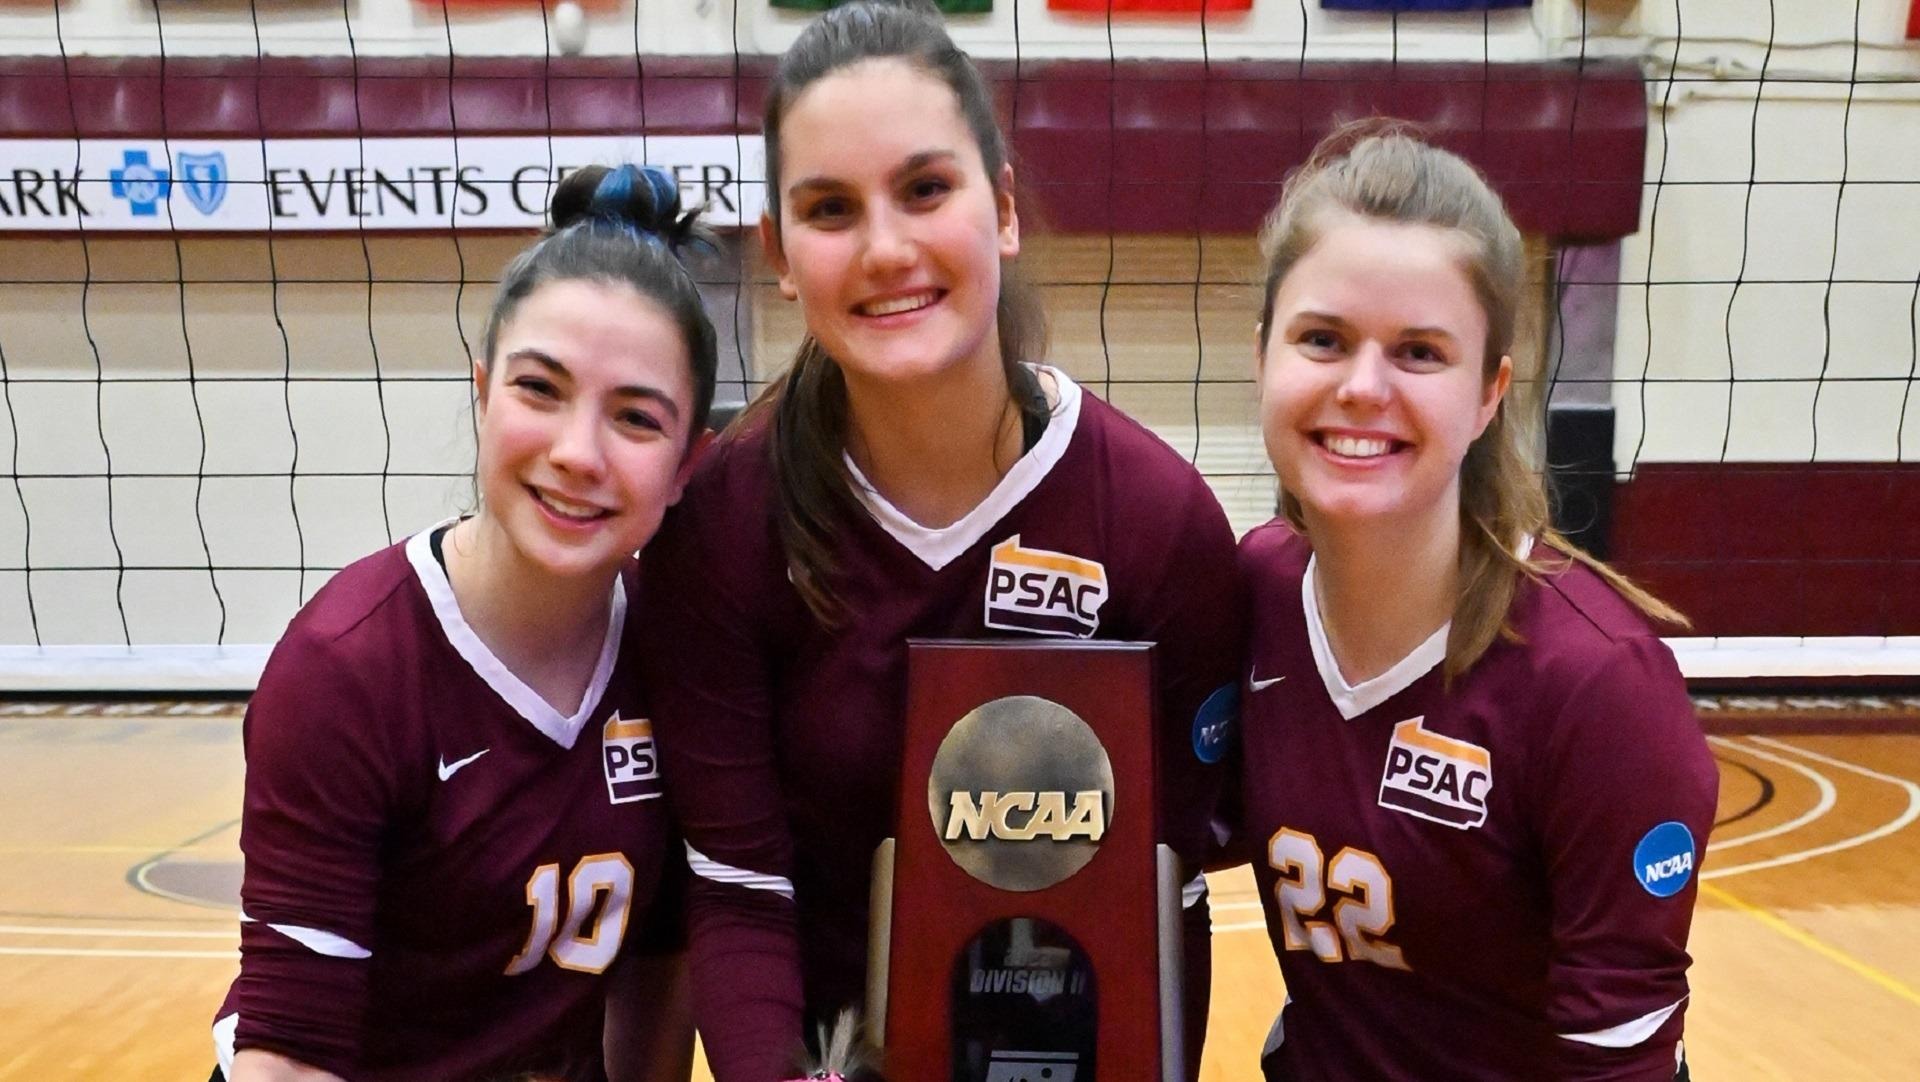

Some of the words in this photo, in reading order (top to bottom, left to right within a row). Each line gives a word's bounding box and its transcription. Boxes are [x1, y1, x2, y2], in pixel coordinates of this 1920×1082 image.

[270, 166, 487, 217] EVENTS
[989, 567, 1101, 621] PSAC
[605, 741, 655, 778] PS
[1385, 746, 1488, 808] PSAC
[945, 790, 1105, 841] NCAA
[1645, 852, 1693, 883] NCAA
[503, 852, 635, 976] 10
[1269, 826, 1413, 972] 22
[970, 968, 1065, 994] DIVISION
